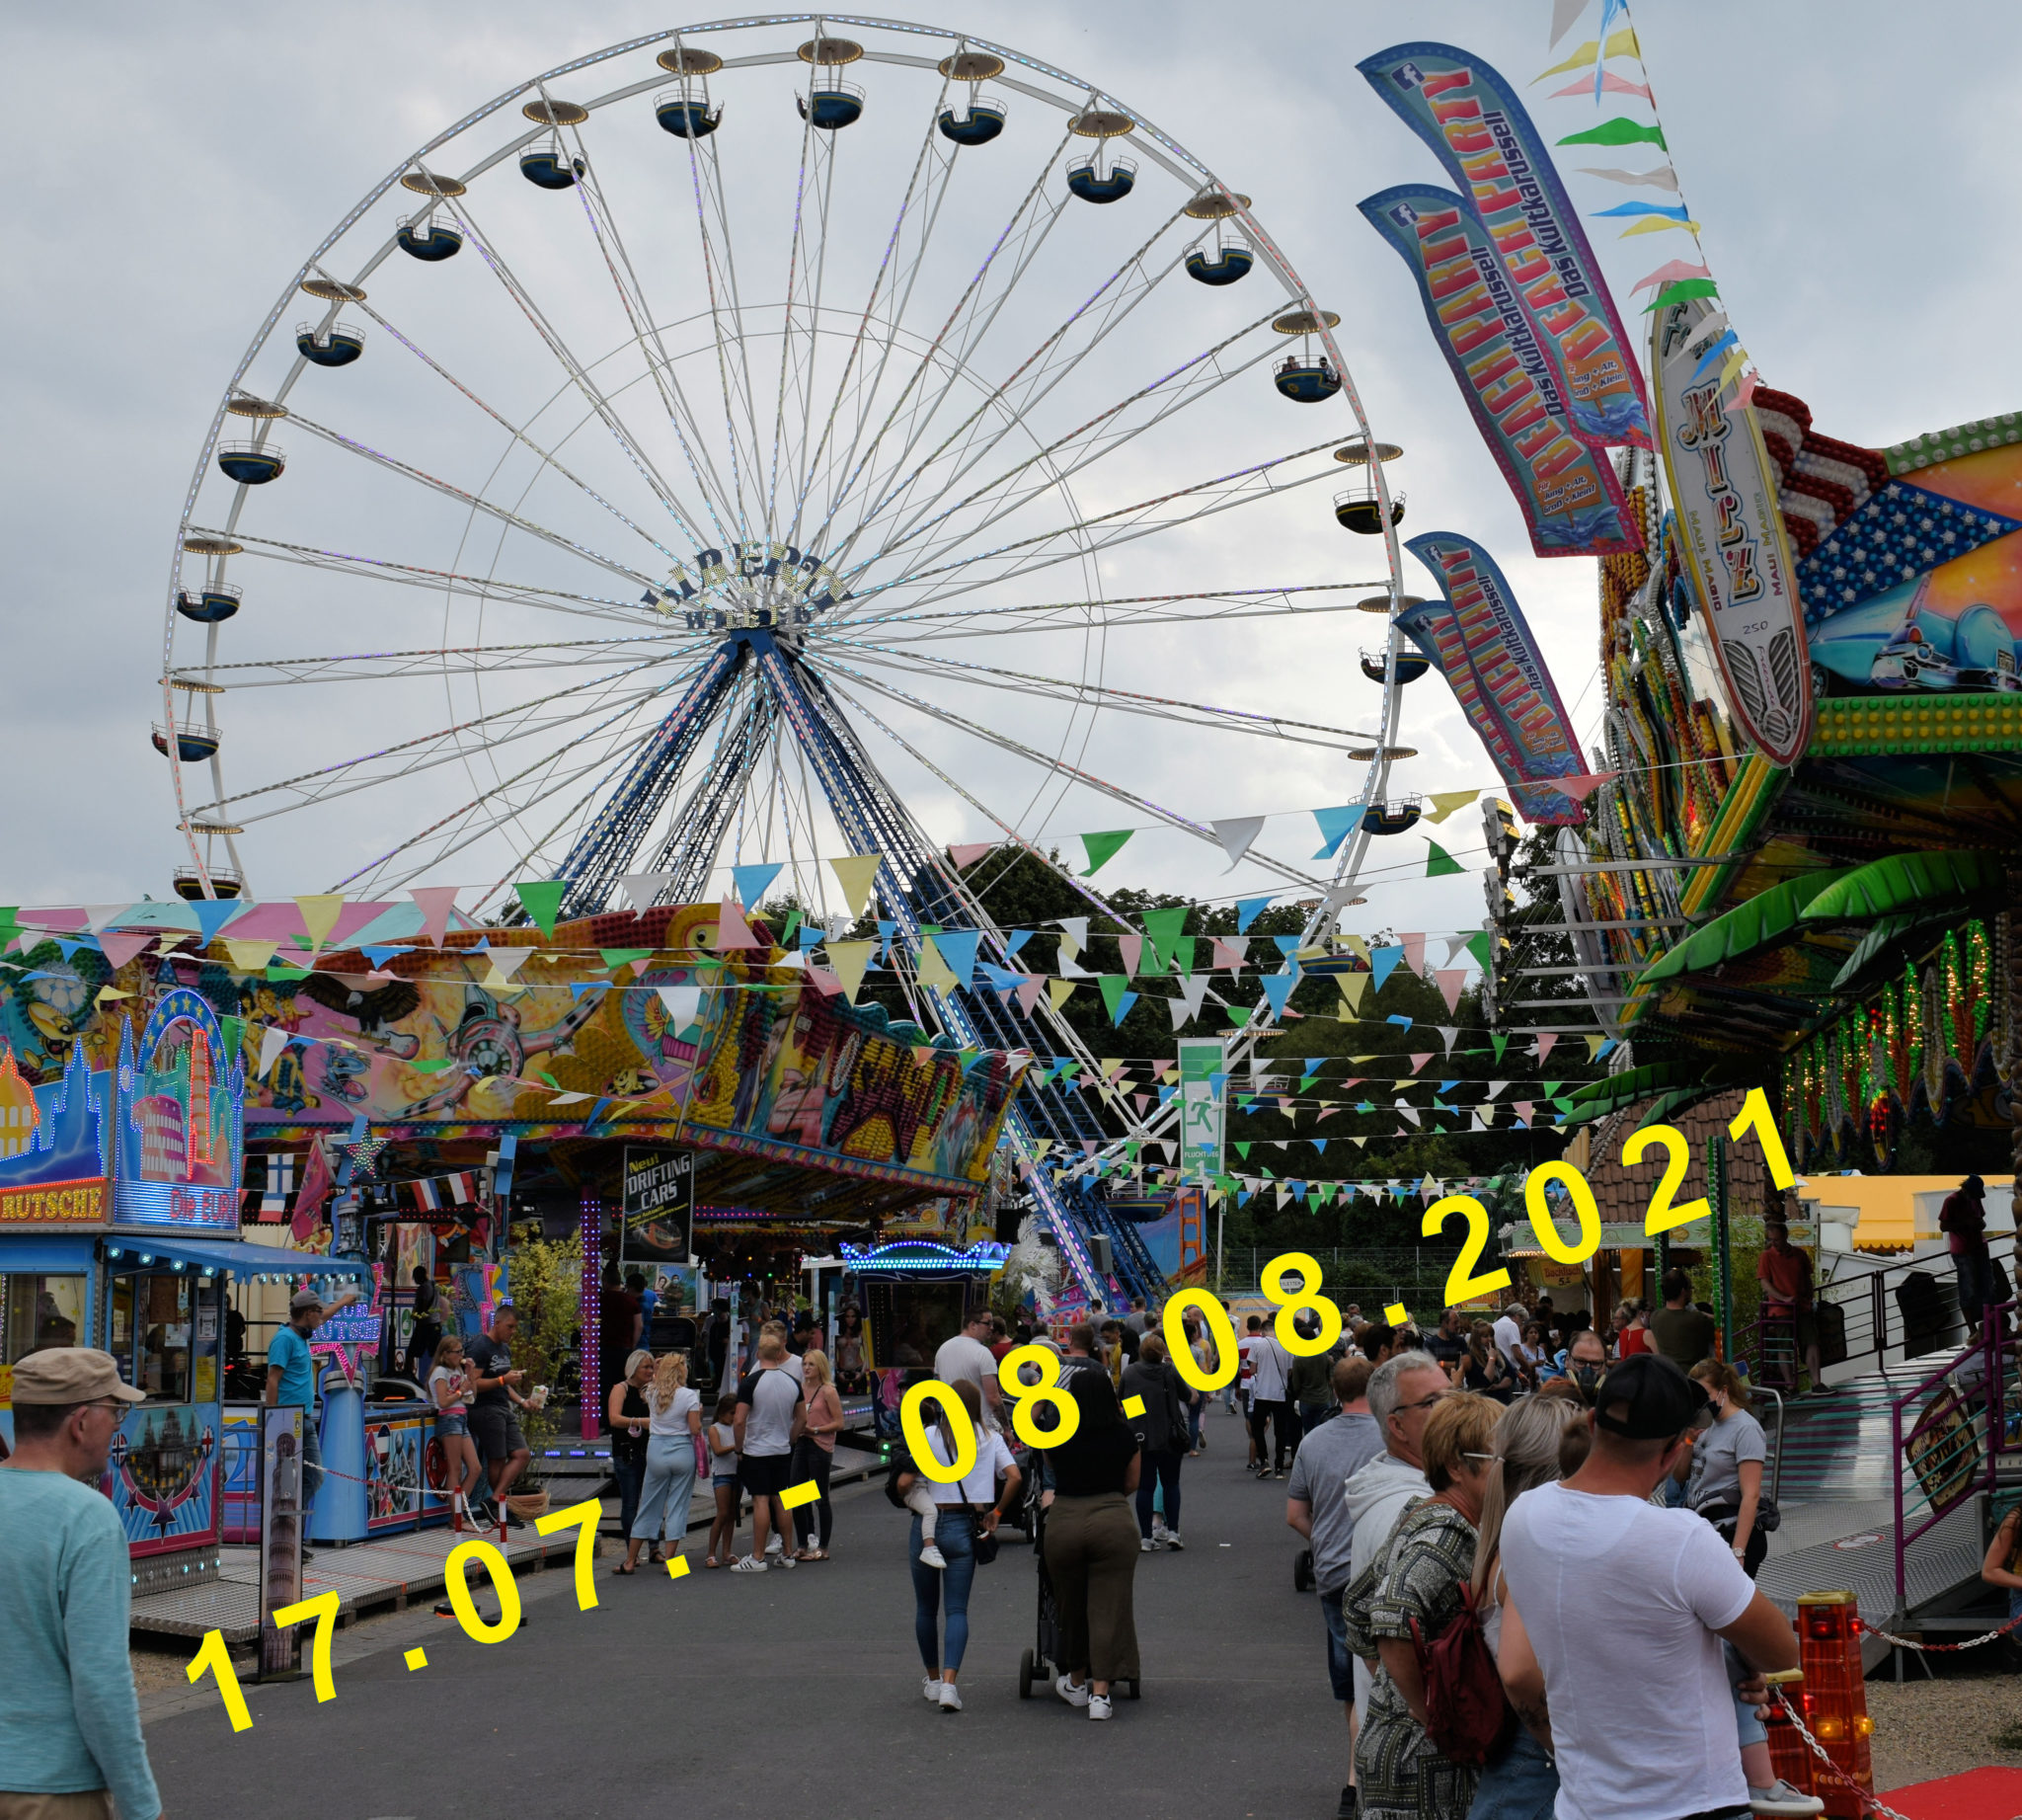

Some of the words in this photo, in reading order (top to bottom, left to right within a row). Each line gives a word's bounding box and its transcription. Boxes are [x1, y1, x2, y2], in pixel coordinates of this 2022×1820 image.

[1421, 66, 1524, 216] PARTY
[1482, 110, 1568, 258] Kultkarussell
[1415, 206, 1509, 356] PARTY
[1488, 218, 1611, 361] BEACH
[1554, 255, 1592, 299] Das
[1470, 245, 1548, 378] Kultkarussell
[1466, 345, 1585, 481] BEACH
[1537, 377, 1566, 419] Das
[1543, 486, 1565, 503] Jung
[1766, 553, 1784, 597] MAUI
[1440, 547, 1503, 654] PARTY
[1477, 575, 1532, 669] Kultkarussell
[1743, 619, 1770, 635] 250
[1475, 643, 1557, 735] BEACH
[1523, 664, 1543, 691] Das
[628, 1152, 660, 1173] Neu!
[628, 1153, 690, 1196] DRIFTING
[1, 1186, 103, 1221] RUTSCHE
[171, 1188, 196, 1221] Die
[641, 1180, 678, 1211] CARS
[332, 1304, 369, 1318] URO
